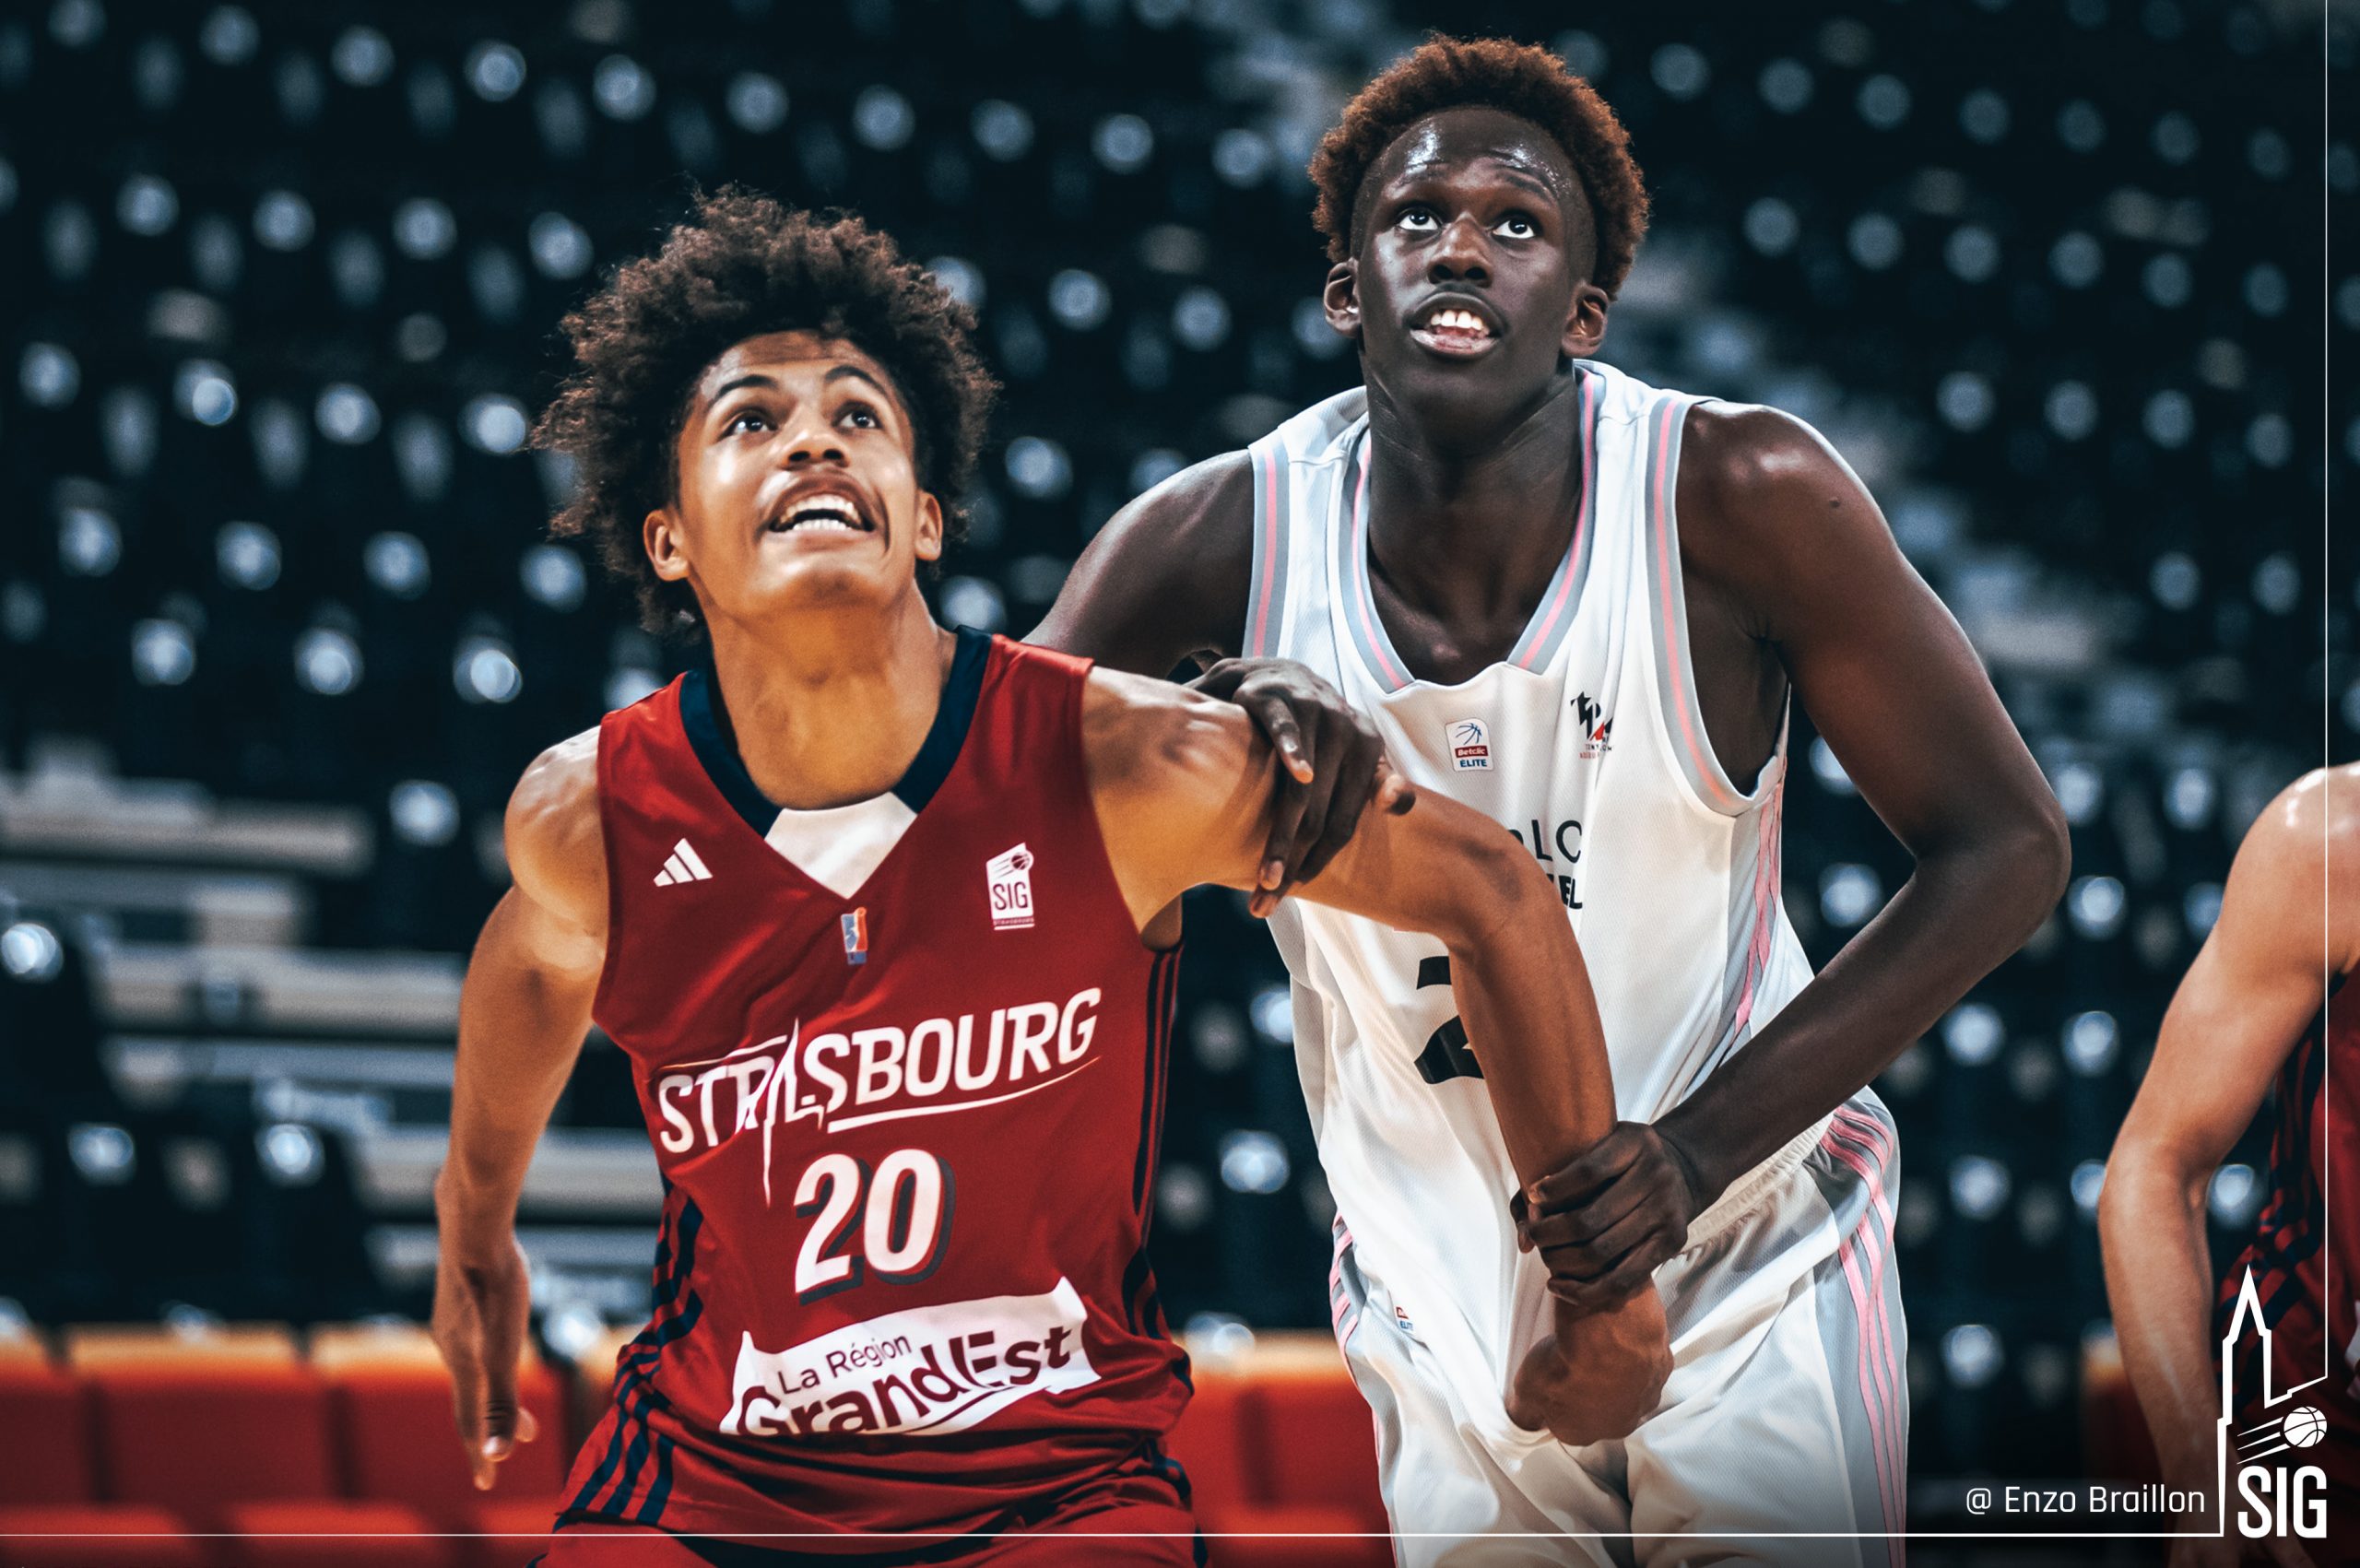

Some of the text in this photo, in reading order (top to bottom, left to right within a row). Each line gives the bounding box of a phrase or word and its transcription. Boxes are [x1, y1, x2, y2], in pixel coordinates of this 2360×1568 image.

[1460, 759, 1488, 768] ELITE
[1508, 819, 1582, 864] LC
[993, 881, 1029, 911] SIG
[1546, 873, 1583, 910] EL
[658, 987, 1102, 1154] STRASBOURG
[794, 1149, 942, 1294] 20
[778, 1335, 913, 1394] La Région
